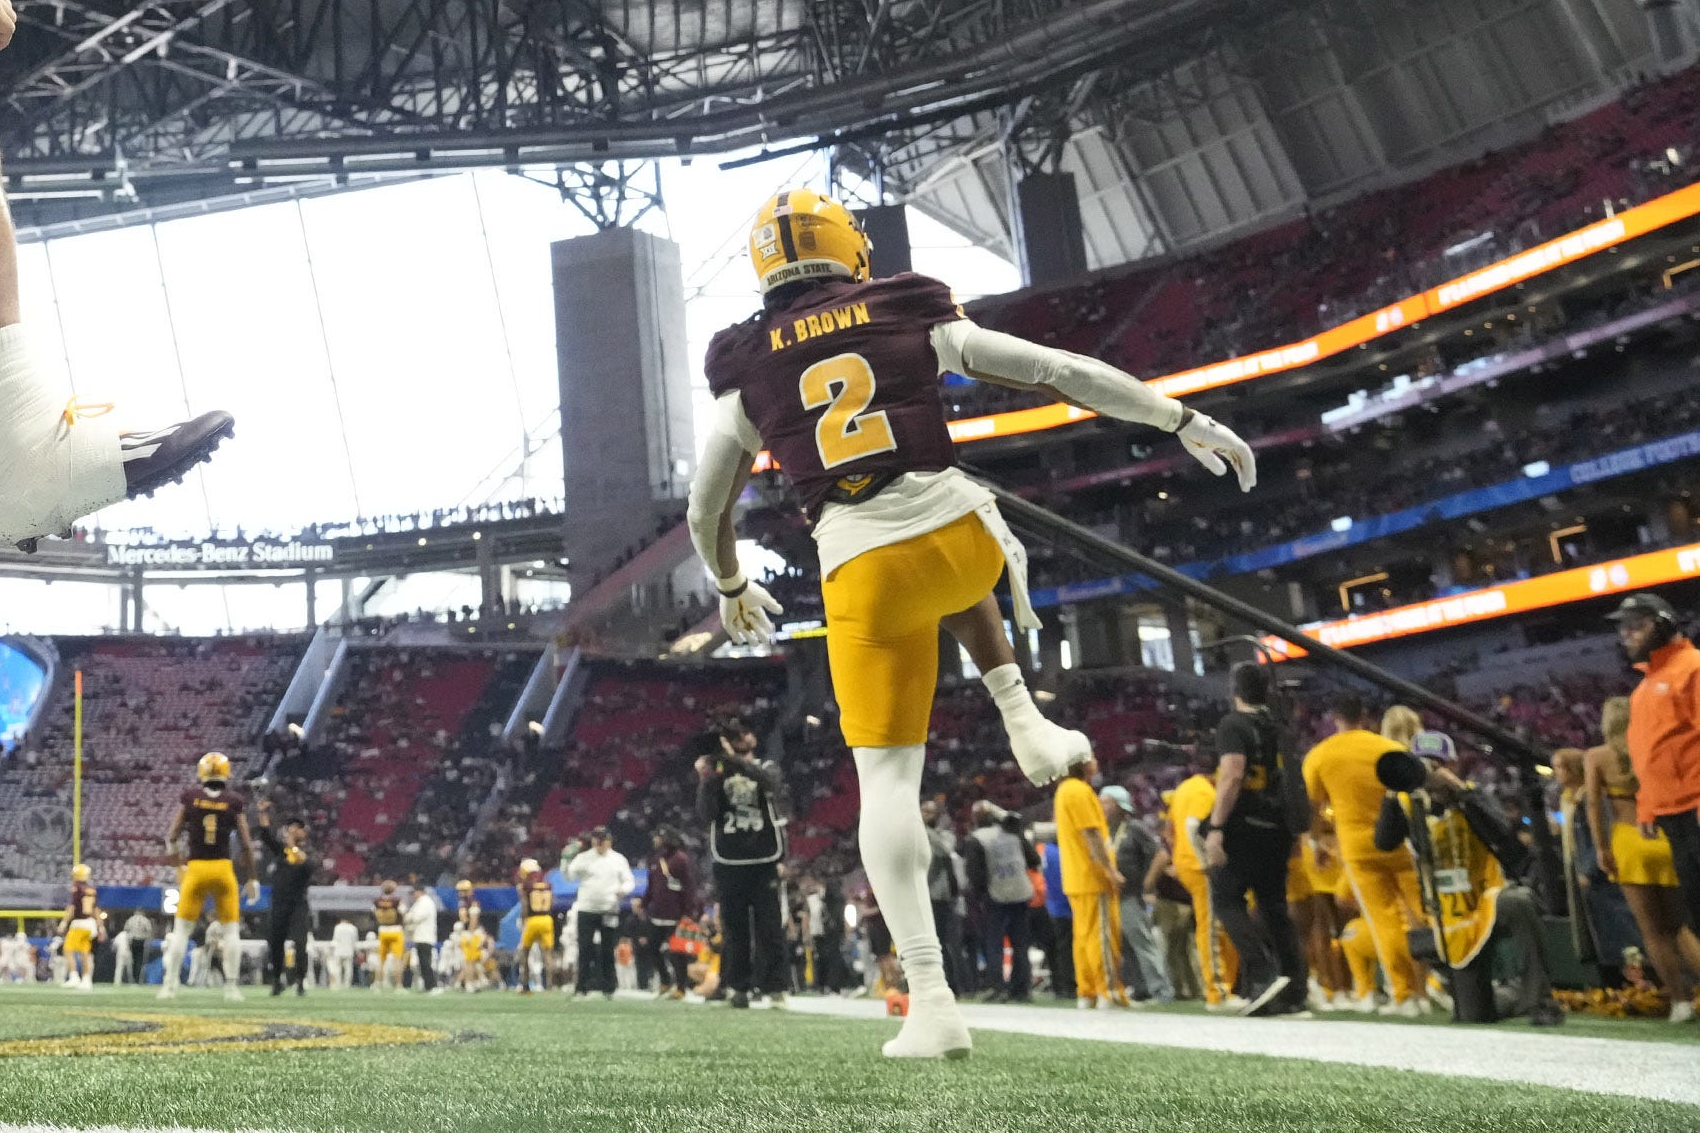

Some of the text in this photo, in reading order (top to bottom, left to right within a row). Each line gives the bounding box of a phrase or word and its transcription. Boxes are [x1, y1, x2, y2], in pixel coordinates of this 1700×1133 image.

[766, 263, 832, 286] ARIZONA STATE
[769, 302, 871, 352] K. BROWN
[798, 352, 897, 470] 2
[108, 541, 334, 565] Mercedes-Benz Stadium
[202, 813, 218, 846] 1
